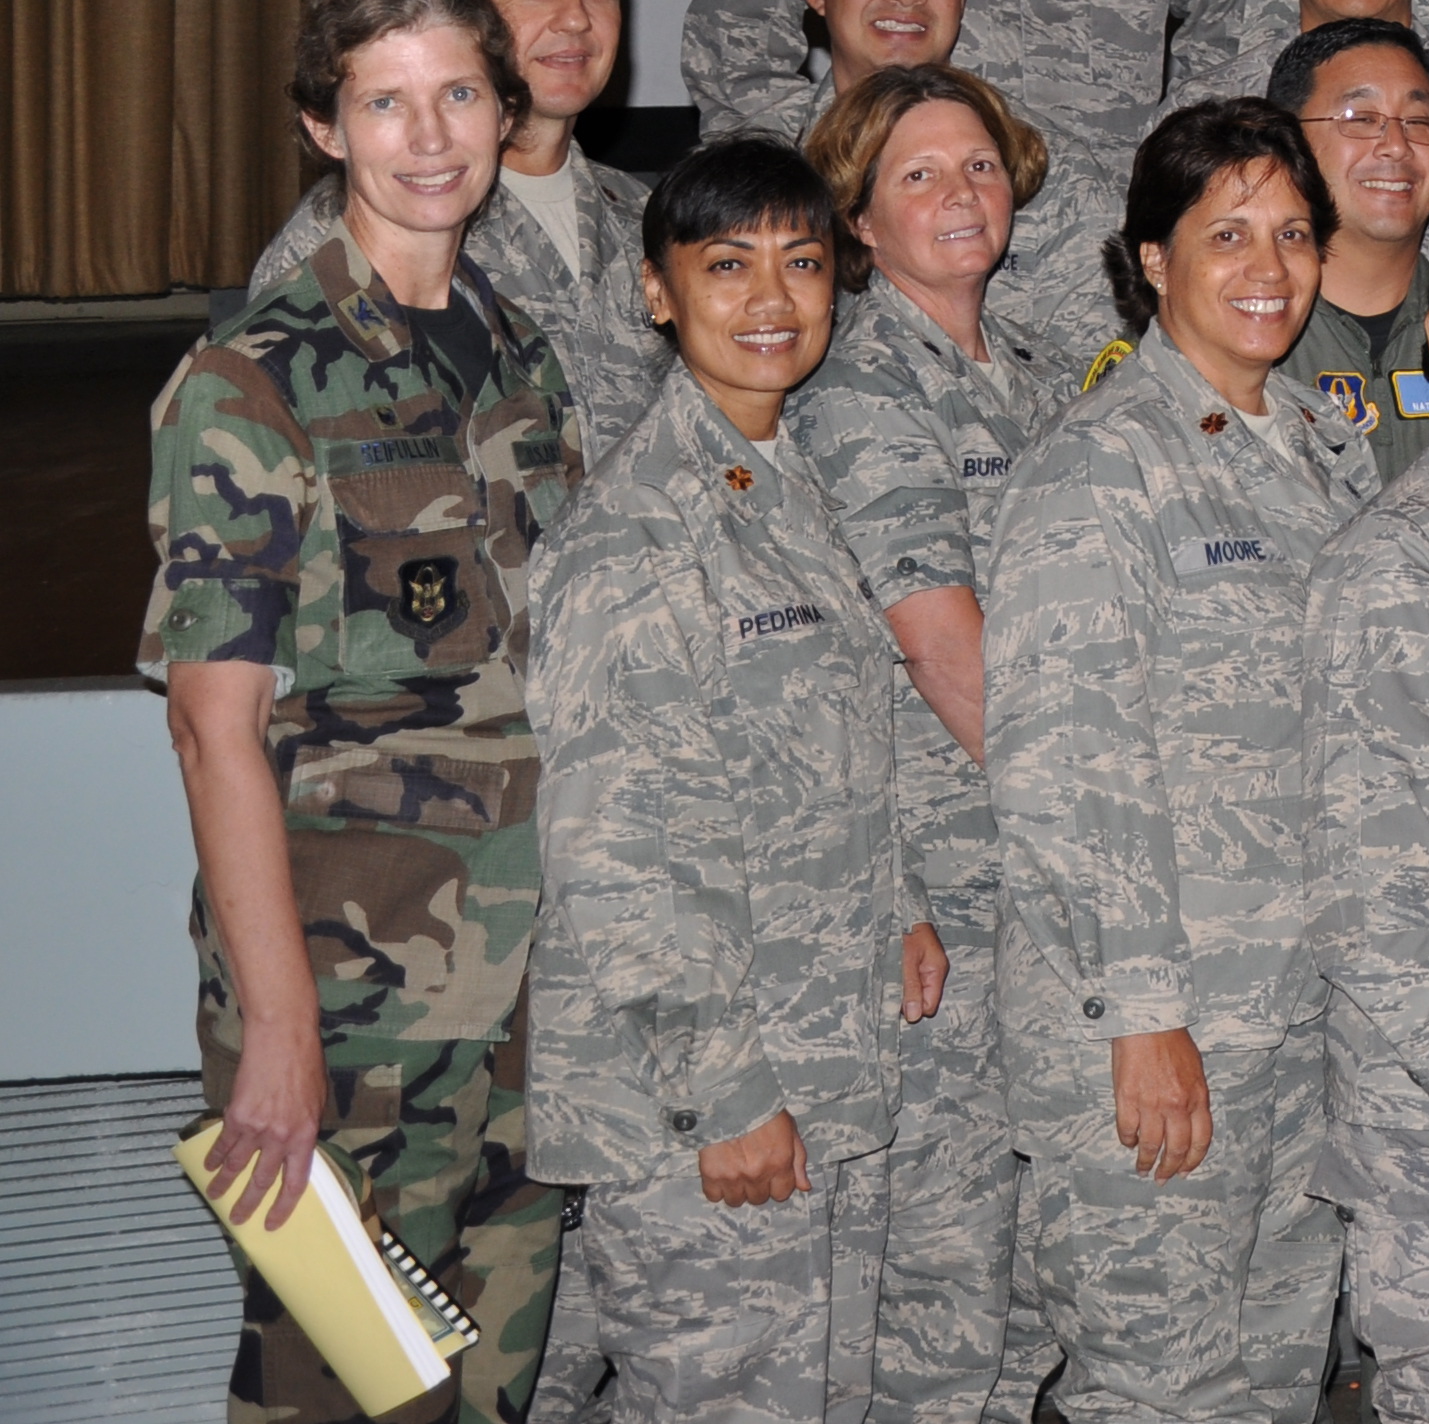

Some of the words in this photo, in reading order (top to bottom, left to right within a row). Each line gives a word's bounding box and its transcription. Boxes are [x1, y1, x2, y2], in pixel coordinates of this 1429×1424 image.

[361, 436, 441, 467] SEIFULLIN
[1204, 539, 1267, 566] MOORE
[738, 604, 826, 639] PEDRINA
